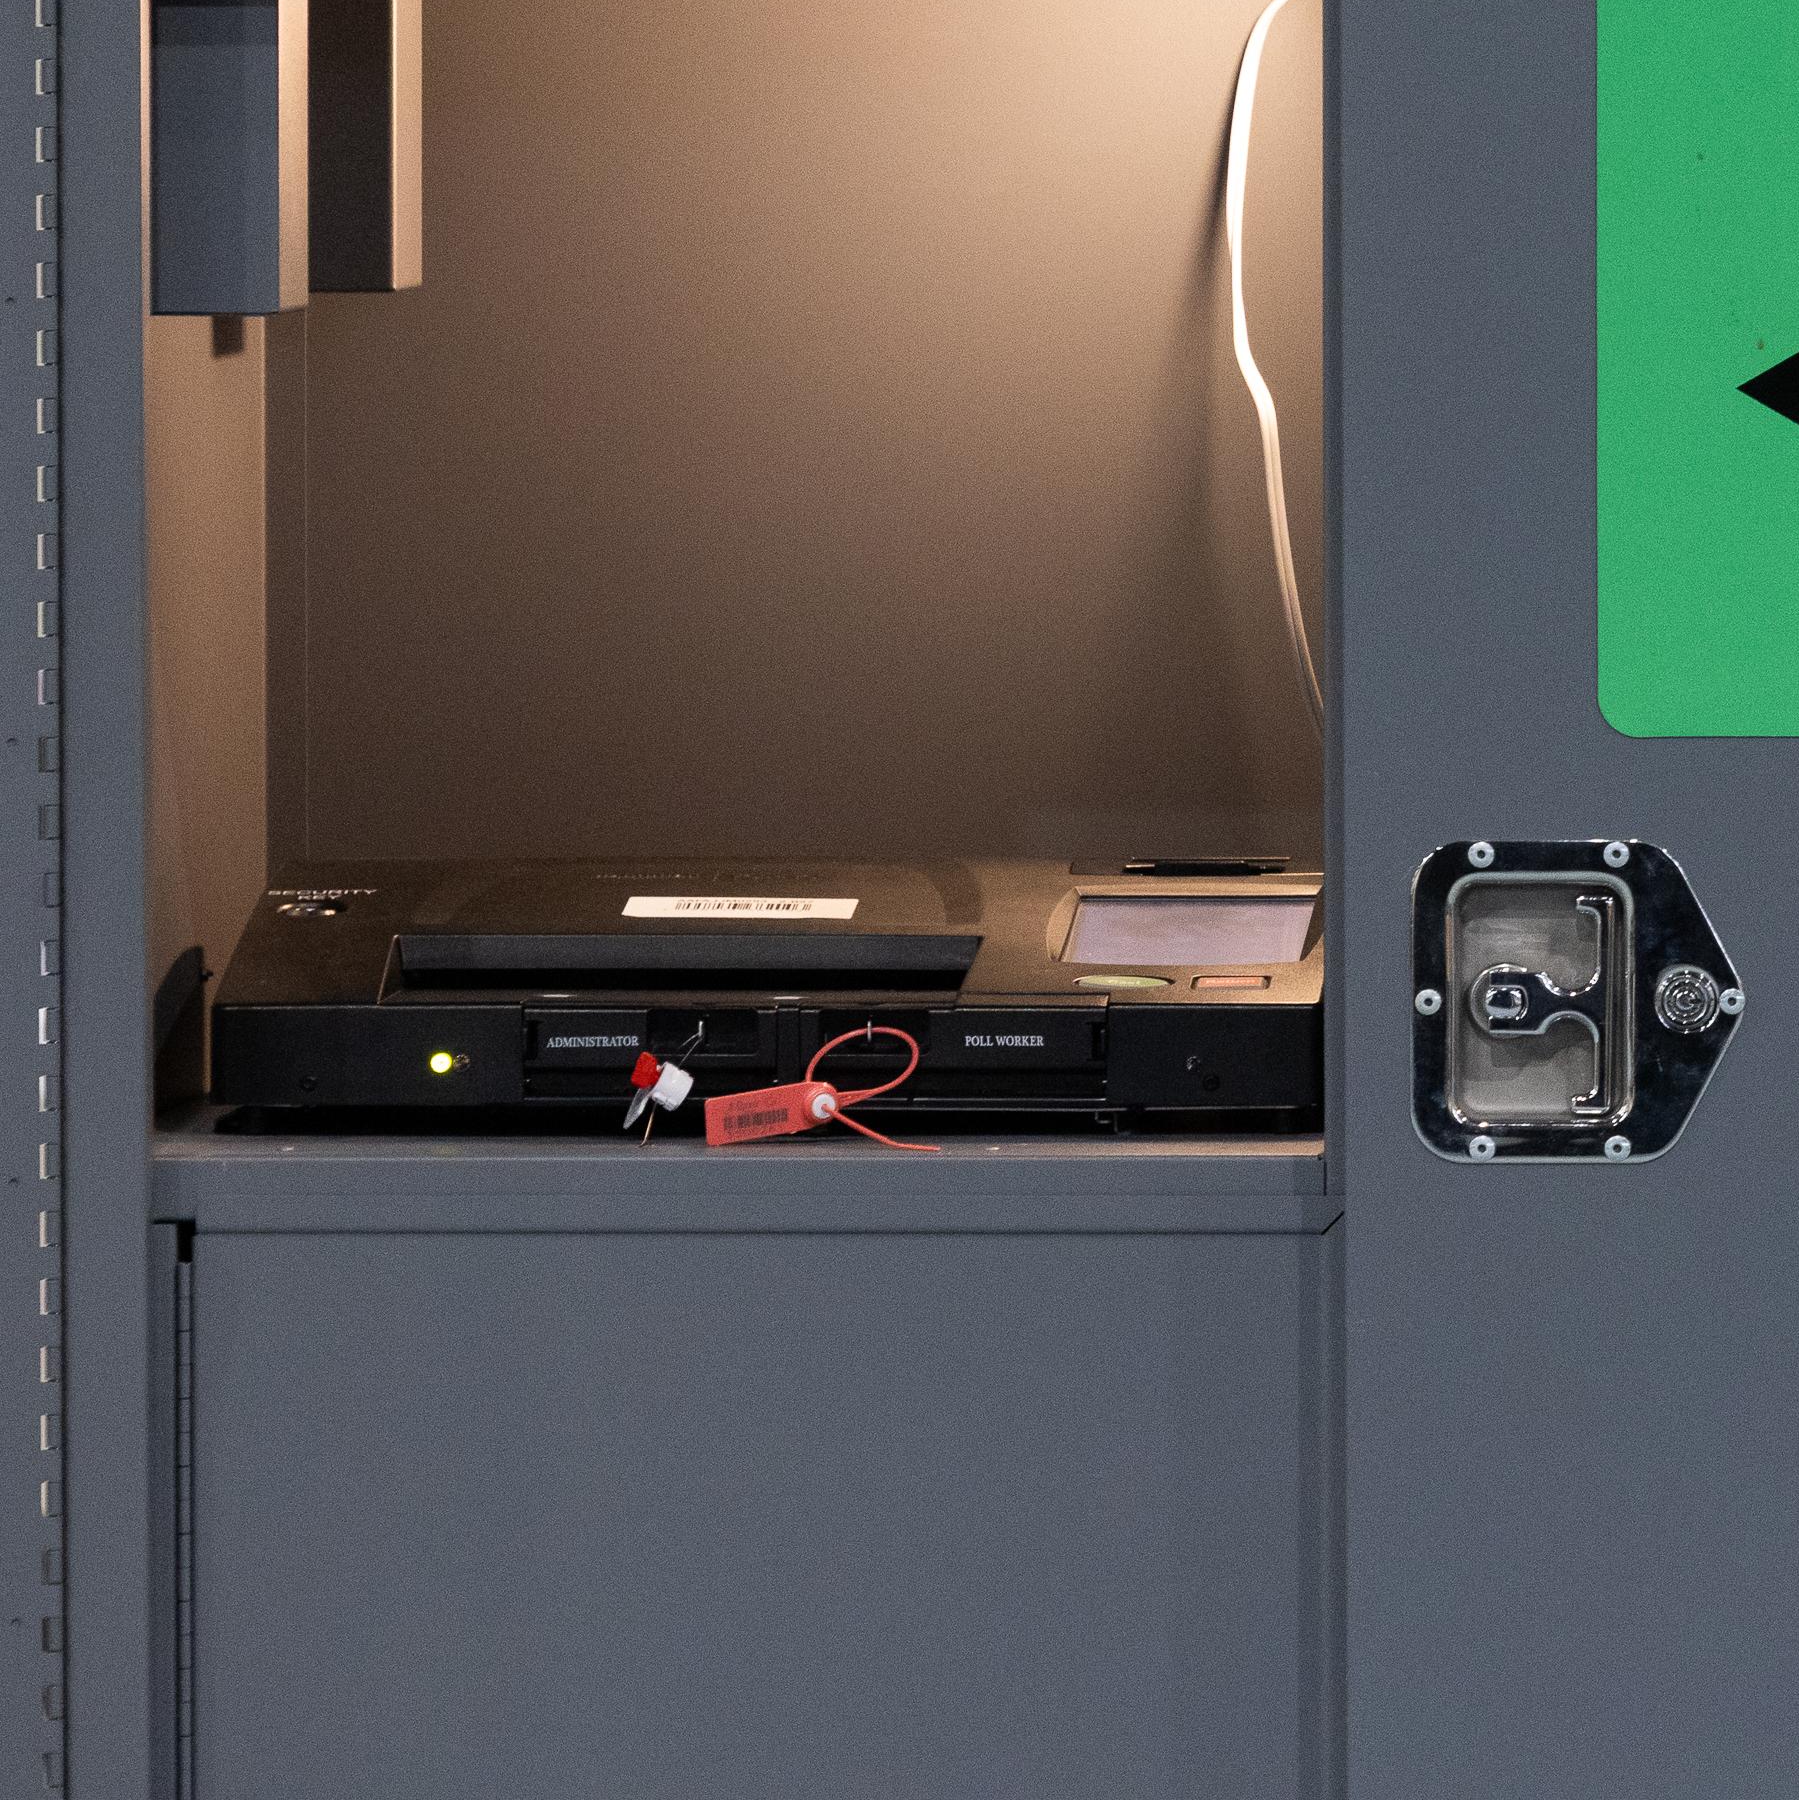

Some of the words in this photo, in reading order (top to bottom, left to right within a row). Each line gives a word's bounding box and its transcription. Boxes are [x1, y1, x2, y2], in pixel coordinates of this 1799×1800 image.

[546, 1035, 640, 1048] ADMINISTRATOR
[965, 1035, 994, 1047] POLL
[995, 1035, 1044, 1047] WORKER
